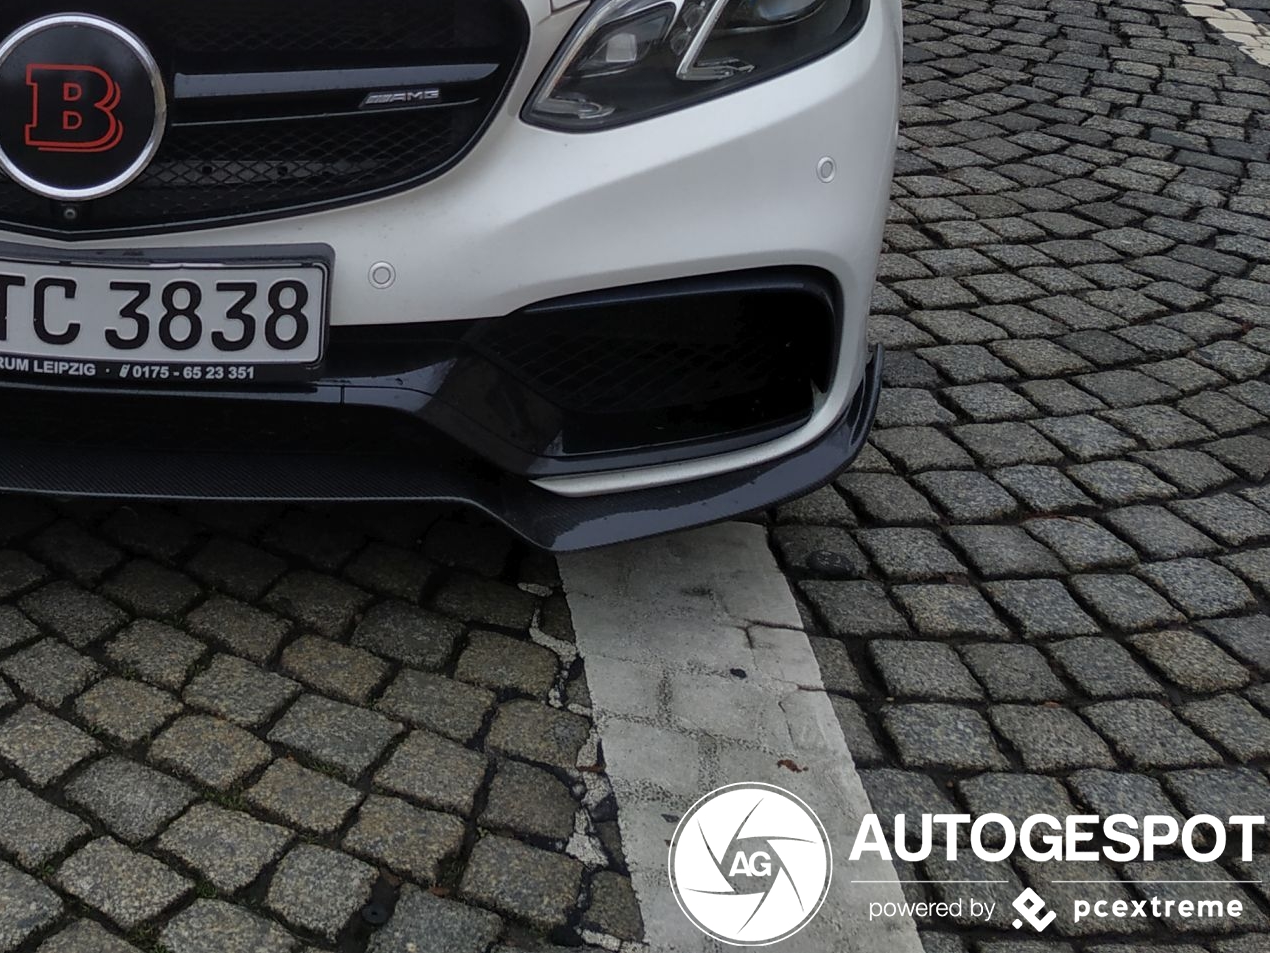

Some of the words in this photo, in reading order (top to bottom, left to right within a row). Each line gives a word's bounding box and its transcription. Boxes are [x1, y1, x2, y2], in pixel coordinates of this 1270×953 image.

[25, 63, 123, 152] B
[104, 280, 310, 351] 3838
[33, 359, 97, 376] LEIPZIG
[132, 365, 169, 378] 0175
[183, 366, 202, 379] 65
[205, 366, 224, 379] 23
[228, 366, 255, 379] 351
